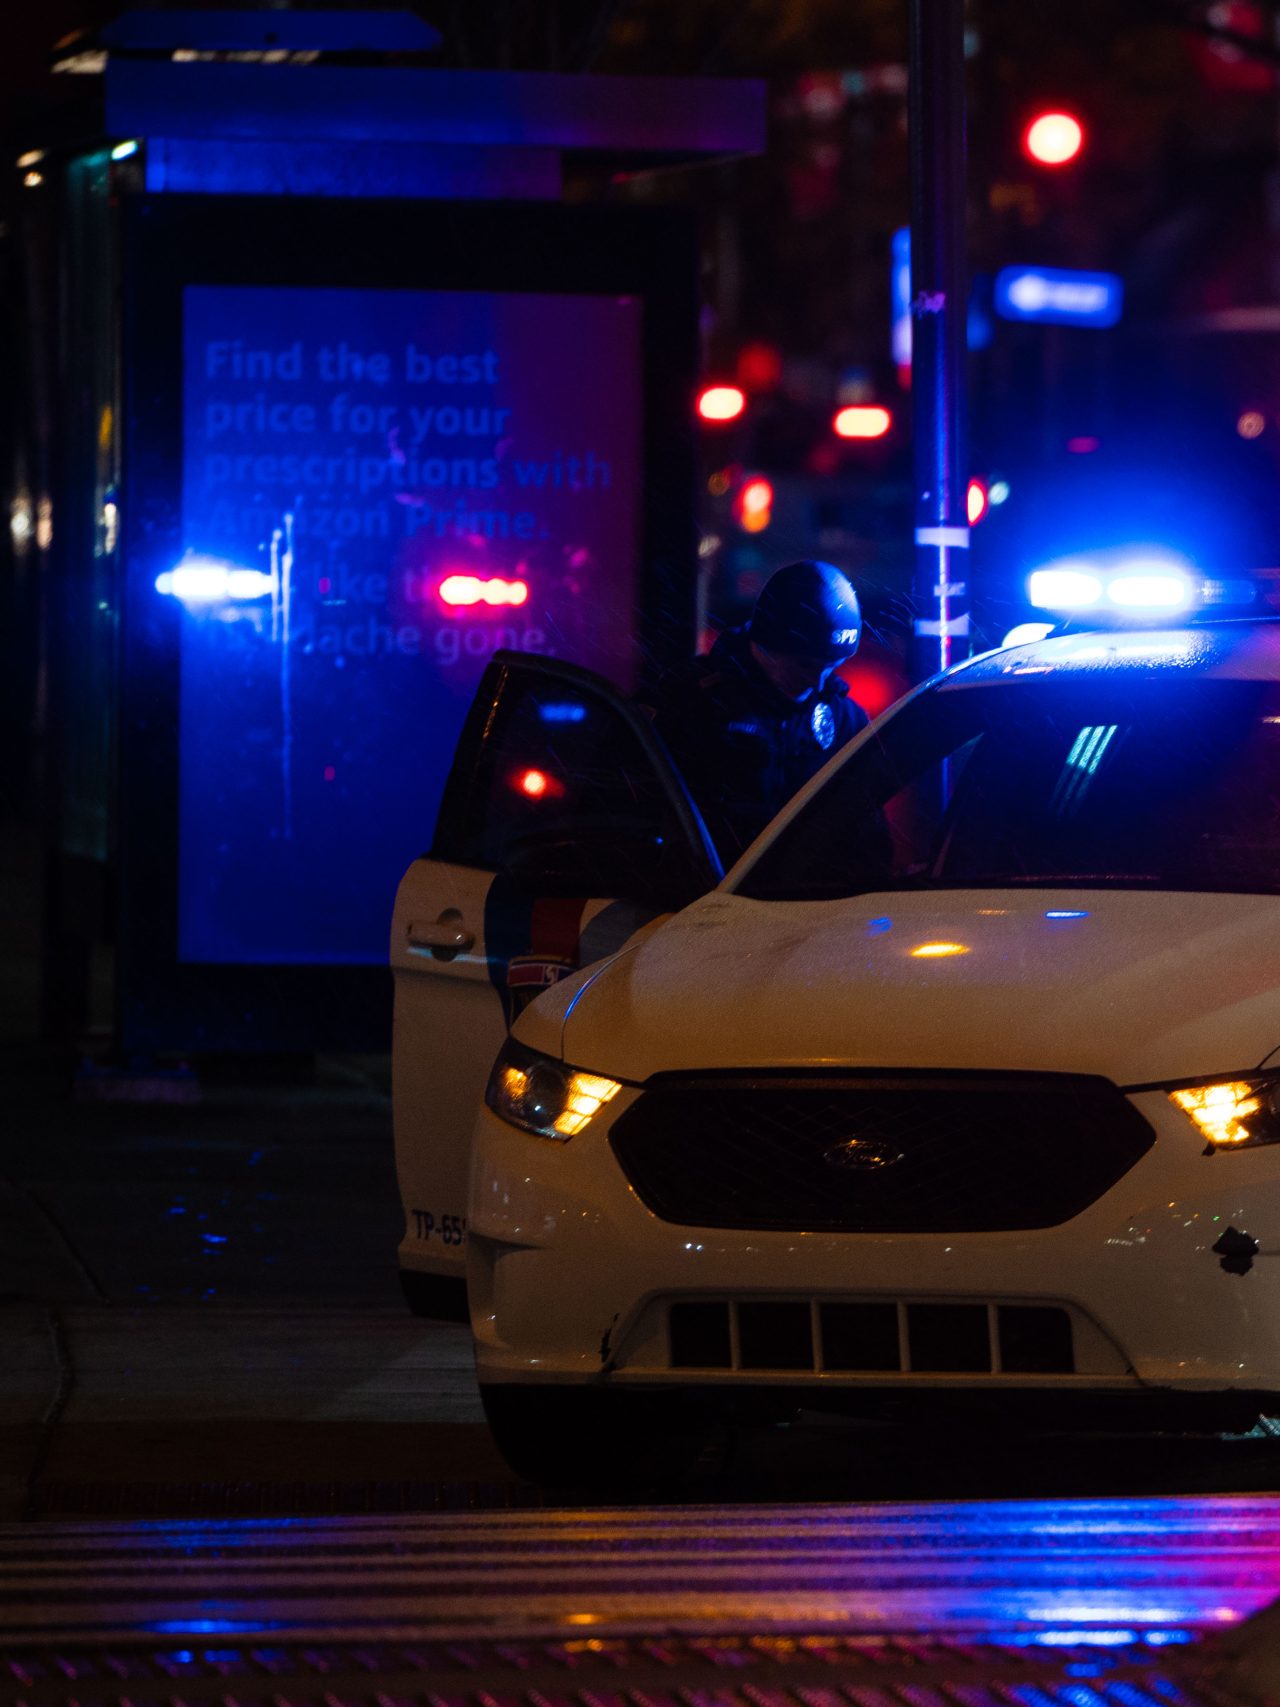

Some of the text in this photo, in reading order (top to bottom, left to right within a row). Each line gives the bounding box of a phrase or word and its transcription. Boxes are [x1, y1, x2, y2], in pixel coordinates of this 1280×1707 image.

[205, 340, 499, 385] Find the best
[205, 392, 512, 444] price for your
[205, 448, 609, 494] prescriptions with
[405, 498, 549, 540] Prime.
